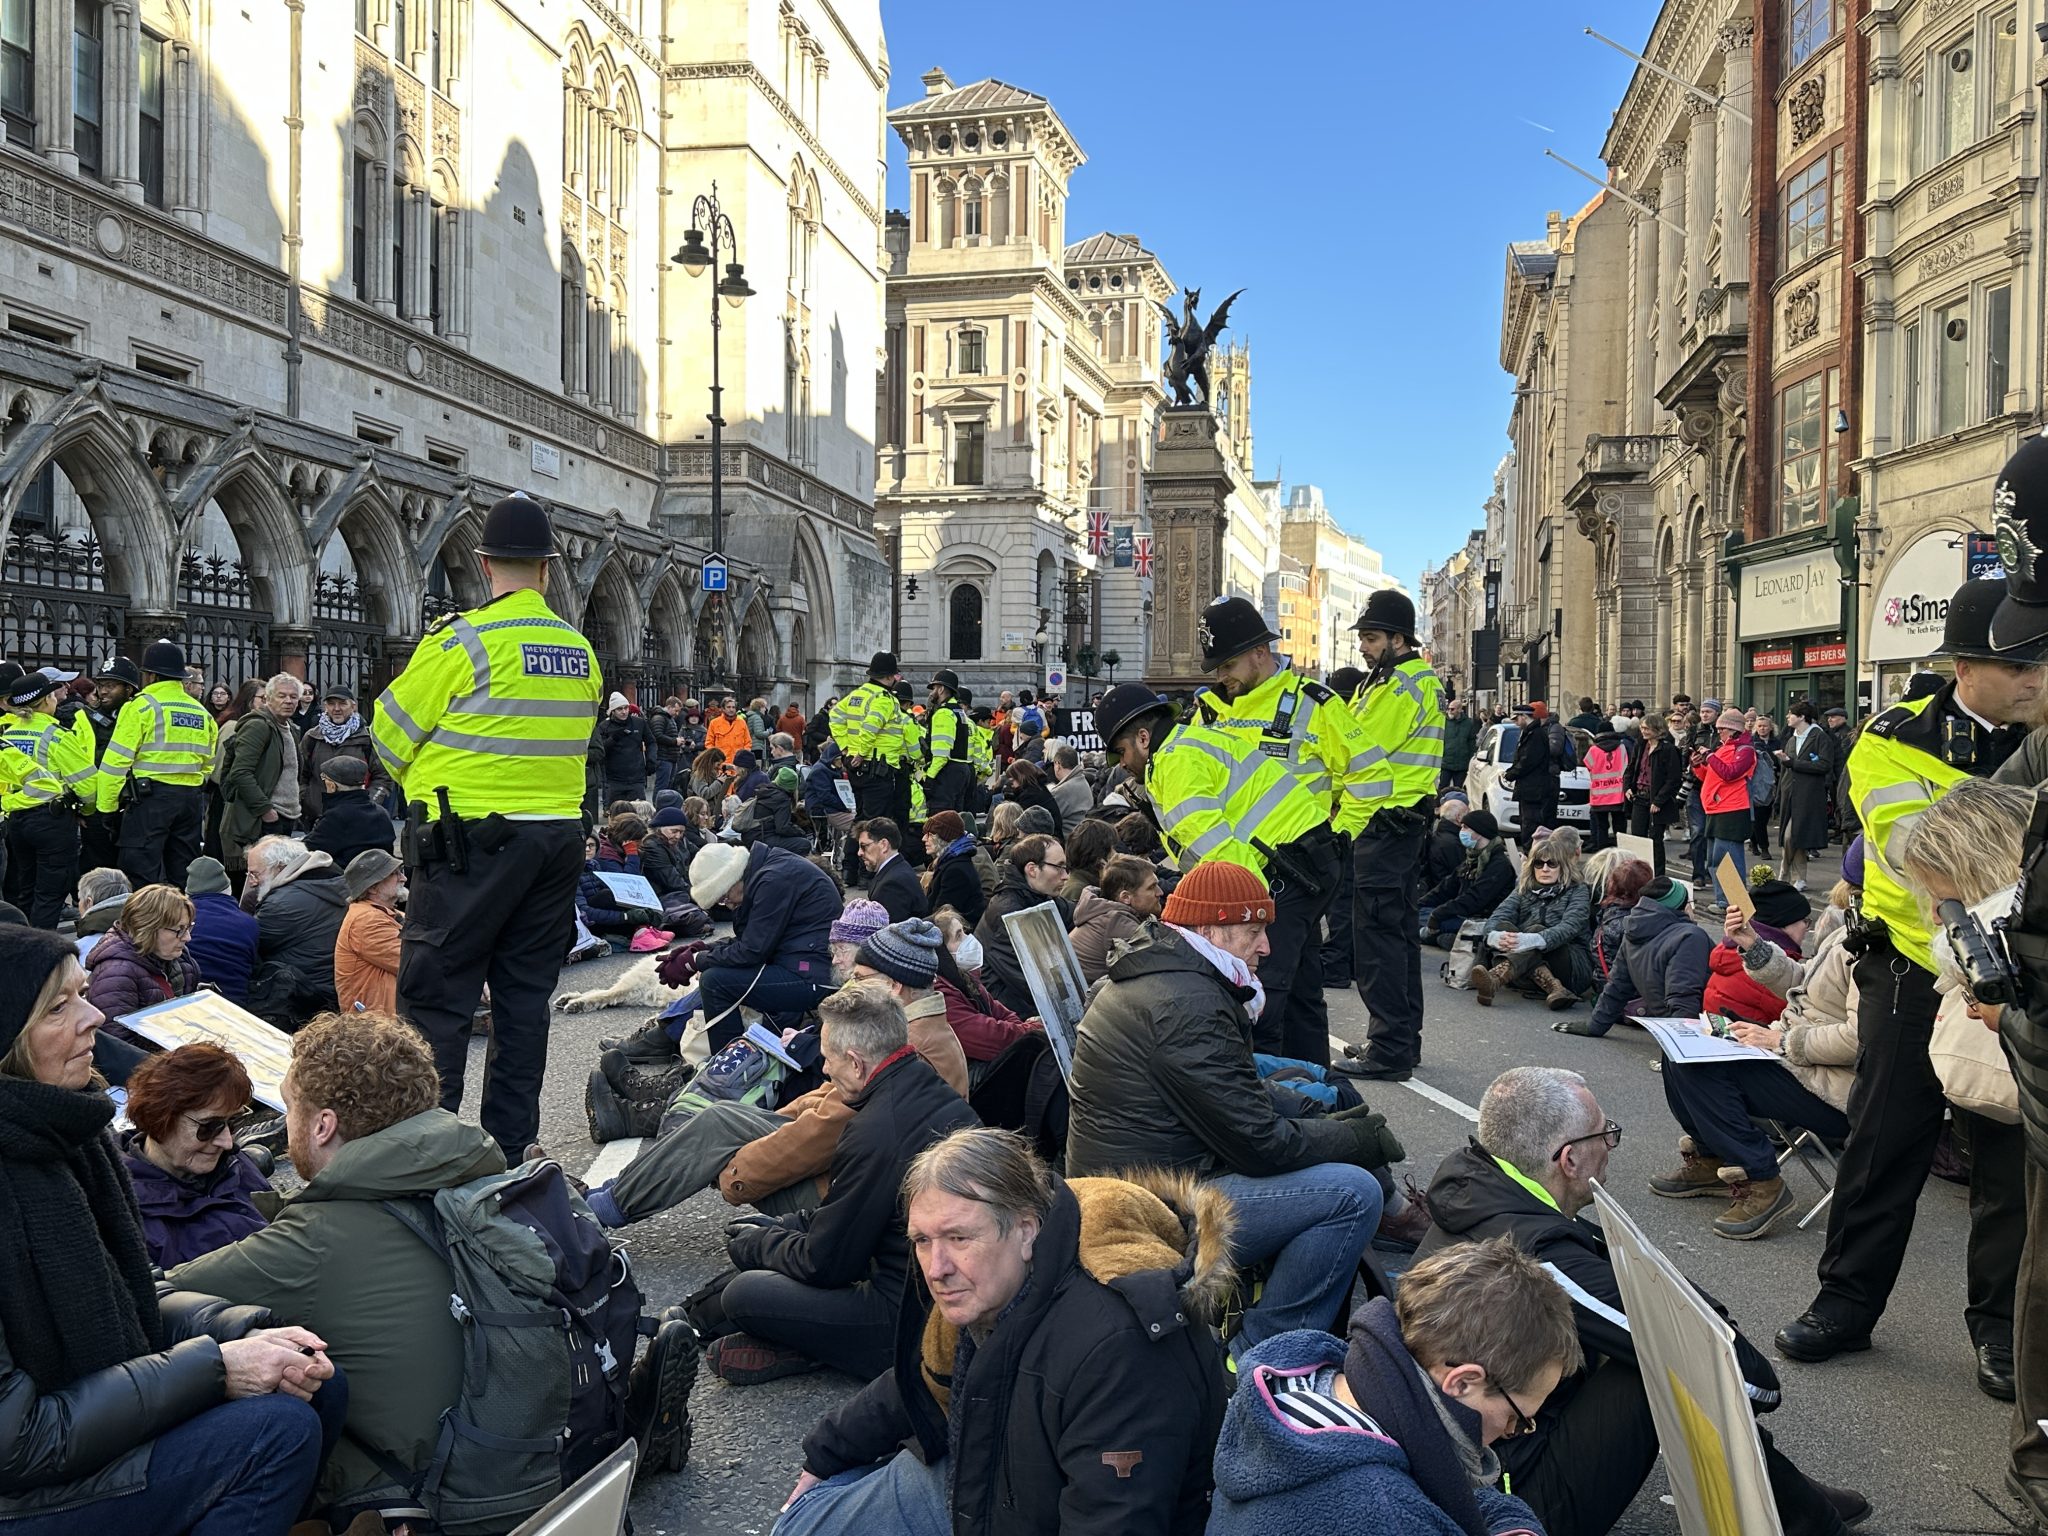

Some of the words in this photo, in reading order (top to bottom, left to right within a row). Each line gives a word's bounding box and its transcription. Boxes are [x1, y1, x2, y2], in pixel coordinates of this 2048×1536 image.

[709, 570, 722, 587] P
[1755, 574, 1804, 598] LEONARD
[1805, 564, 1826, 594] JAY
[1902, 594, 1949, 623] tSma
[524, 645, 587, 657] METROPOLITAN
[1804, 651, 1819, 662] BEST
[1820, 650, 1836, 660] EVER
[1837, 649, 1846, 659] SA
[526, 654, 589, 676] POLICE
[1753, 656, 1767, 667] BEST
[1767, 655, 1781, 666] EVER
[1781, 653, 1793, 664] SAL
[172, 717, 204, 729] POLICE
[1071, 711, 1095, 732] FR
[1567, 809, 1582, 817] LZF
